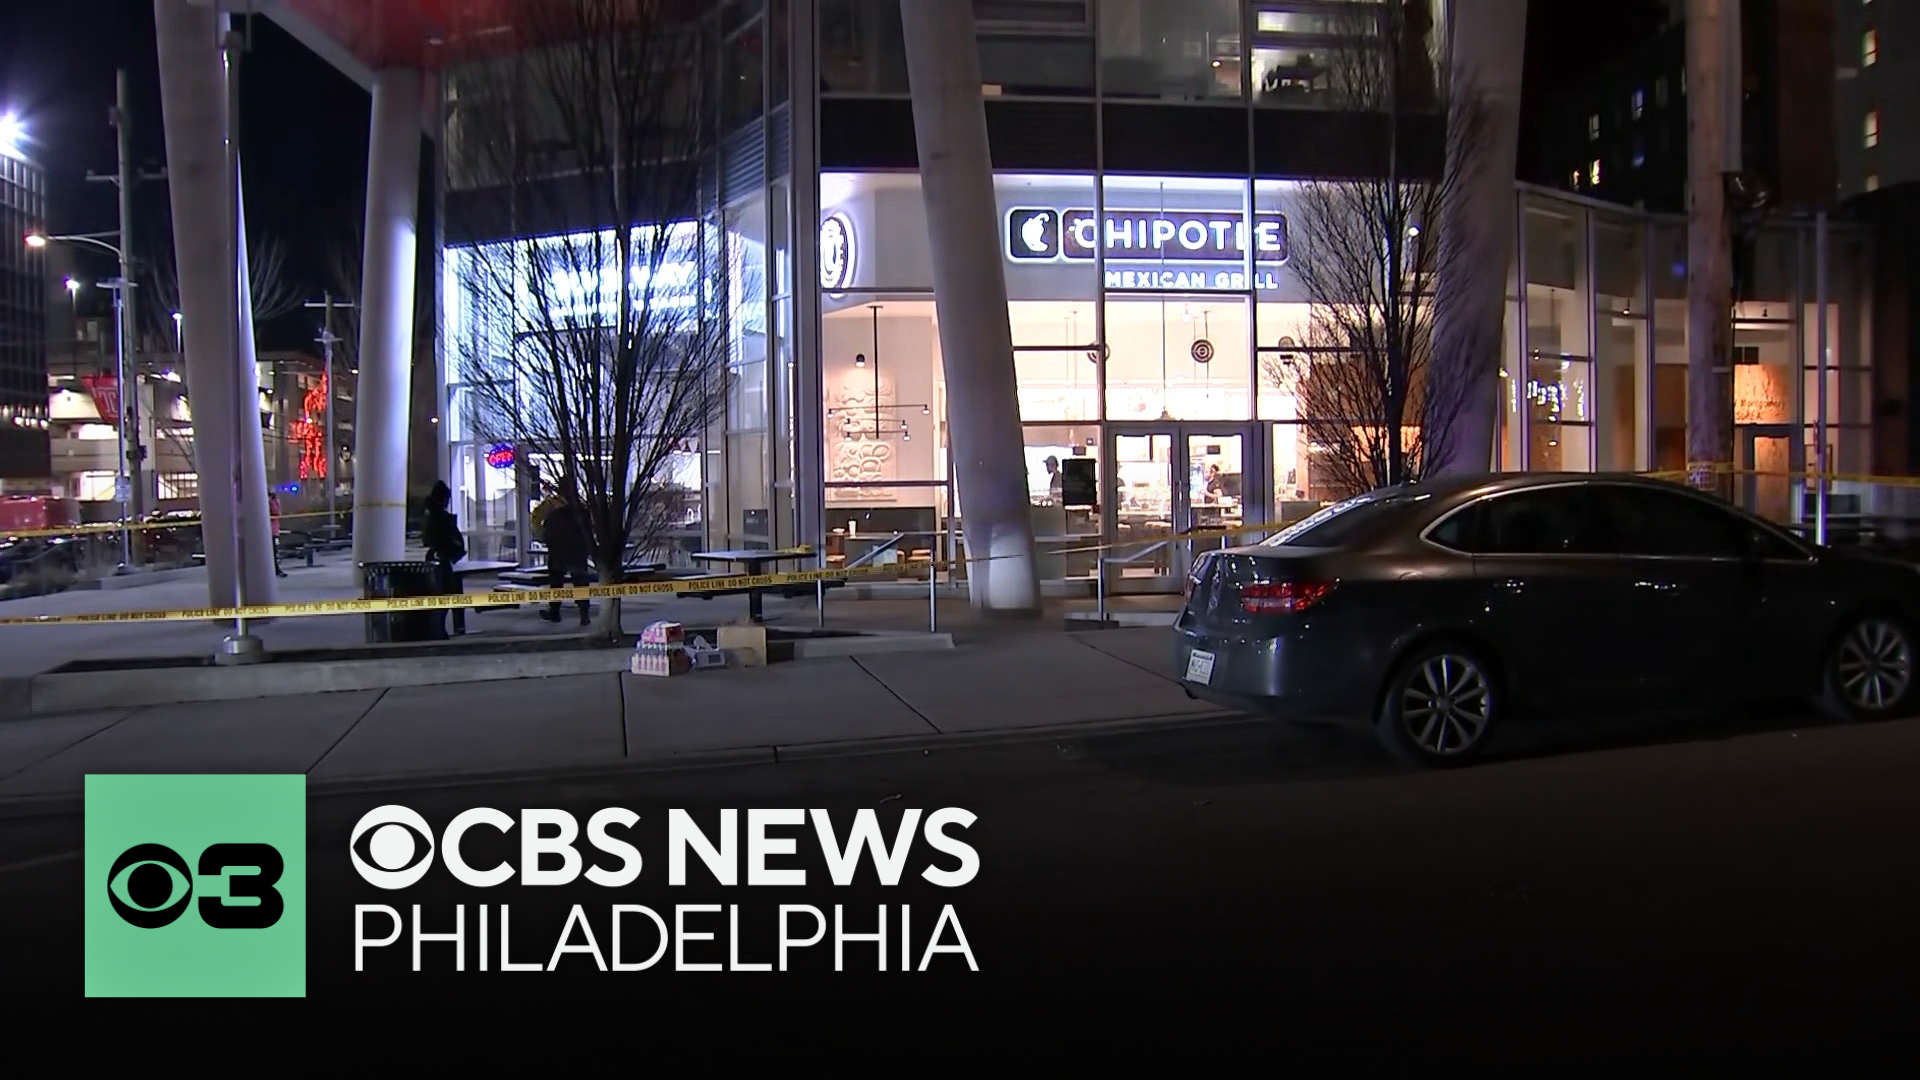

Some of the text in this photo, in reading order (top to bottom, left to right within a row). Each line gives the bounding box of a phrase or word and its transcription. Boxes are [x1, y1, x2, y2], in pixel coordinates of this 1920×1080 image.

[1069, 218, 1281, 251] CHIPOTLE
[1104, 271, 1279, 290] MEXICAN GRLL
[589, 583, 674, 596] POLICE LINE DO NOT CROSS
[688, 576, 772, 590] POLICE LINE DO NOT CROSS
[488, 590, 574, 602] POLICE LINE DO NOT CROSS
[387, 600, 408, 608] POLICE
[427, 598, 436, 606] DO
